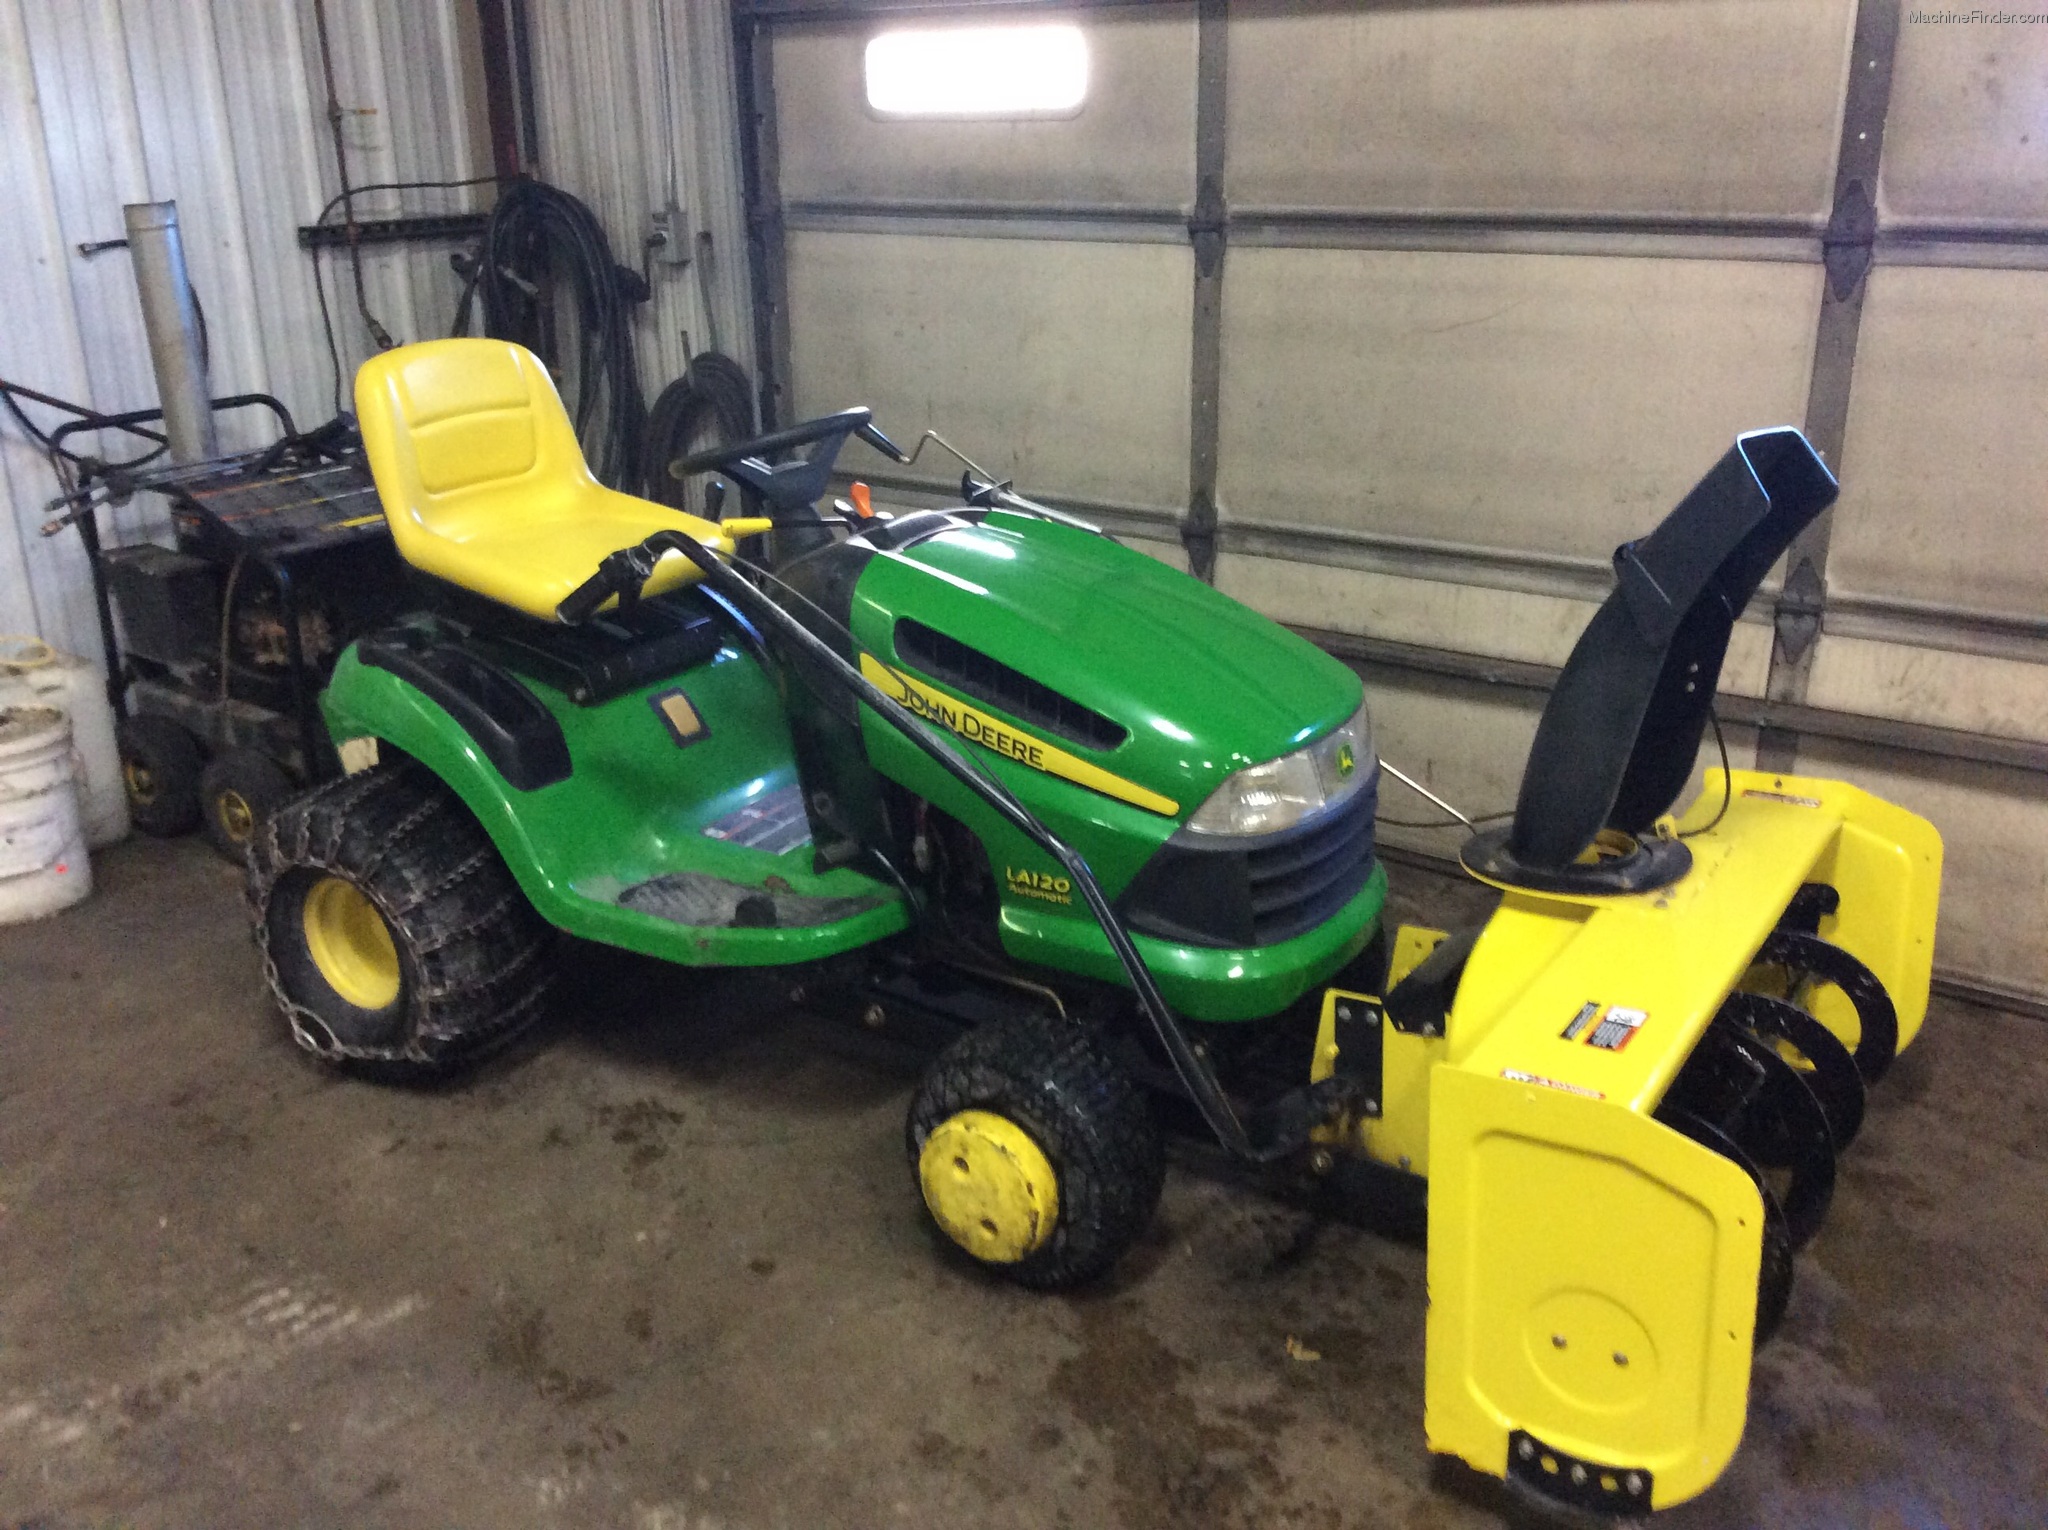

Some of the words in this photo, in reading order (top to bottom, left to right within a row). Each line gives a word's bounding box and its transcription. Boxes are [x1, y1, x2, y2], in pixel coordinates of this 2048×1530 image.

[897, 688, 956, 727] JOHN
[963, 712, 1044, 768] DEERE
[1006, 866, 1070, 893] LA120
